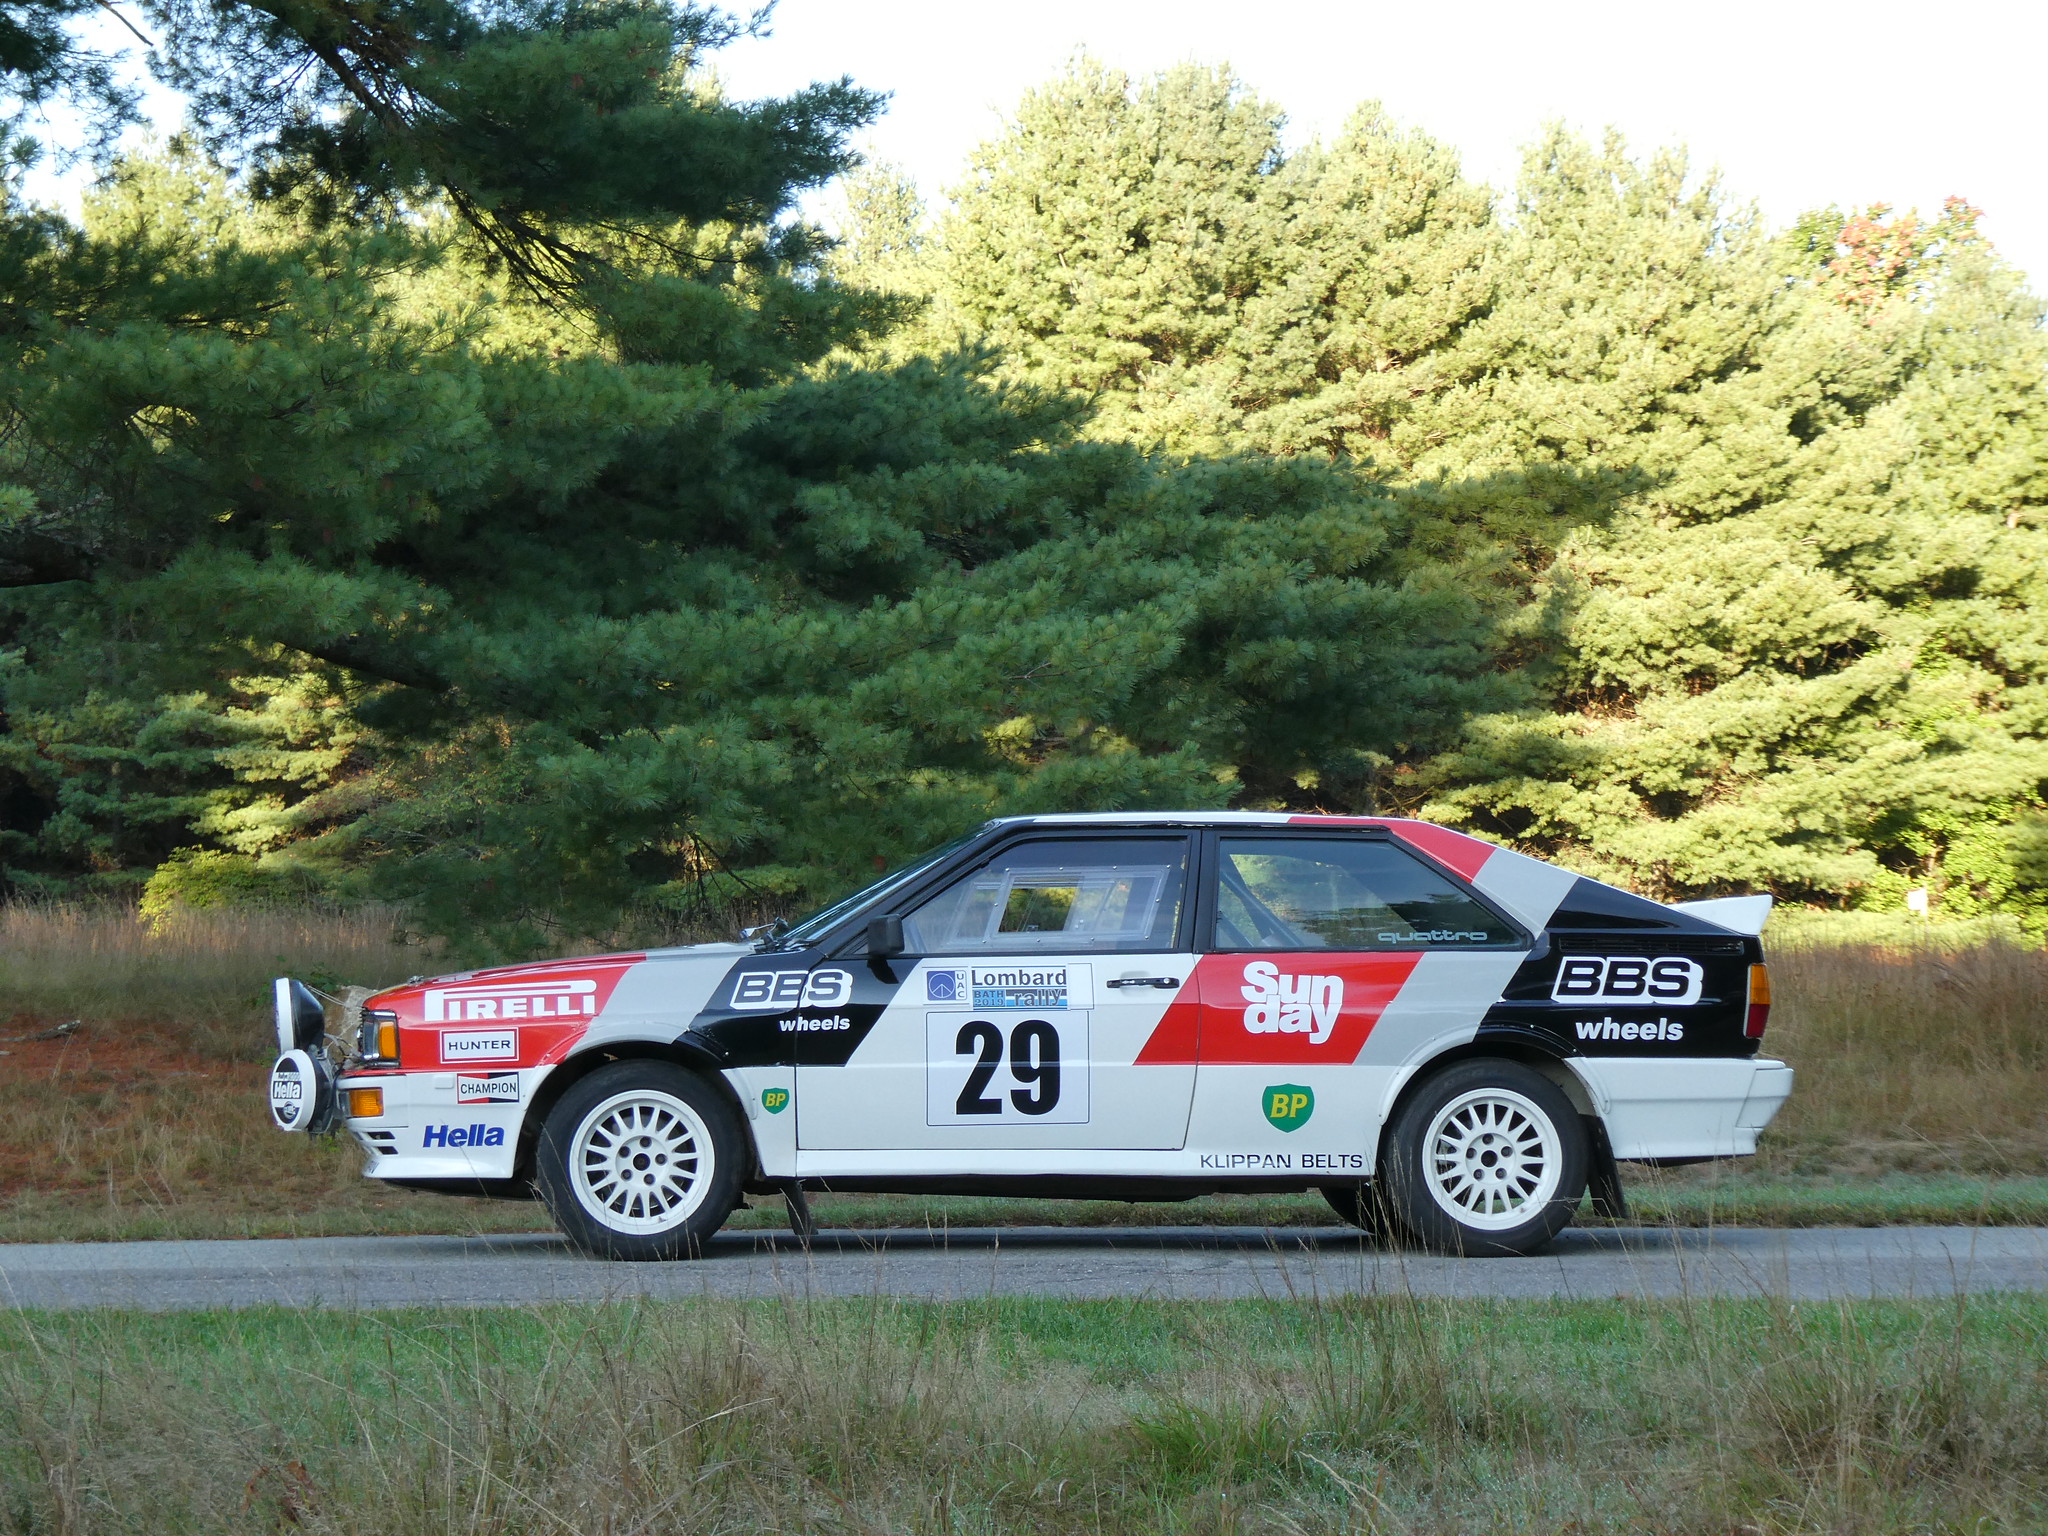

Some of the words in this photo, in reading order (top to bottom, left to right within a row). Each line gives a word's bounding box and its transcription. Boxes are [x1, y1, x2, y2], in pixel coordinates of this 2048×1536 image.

[1377, 929, 1488, 943] quattro
[971, 969, 1067, 986] Lombard
[1240, 961, 1344, 1004] Sun
[1550, 956, 1704, 1006] BBS
[729, 968, 853, 1010] BBS
[974, 990, 1004, 998] BATH
[1014, 988, 1063, 1007] rally
[424, 979, 597, 1022] PIRELLI
[974, 998, 1004, 1007] 2019
[779, 1015, 850, 1031] wheels
[1243, 994, 1343, 1045] day
[1575, 1017, 1684, 1041] wheels
[447, 1039, 511, 1050] HUNTER
[955, 1019, 1061, 1115] 29
[273, 1081, 301, 1099] Hella
[460, 1082, 517, 1094] CHAMPION
[765, 1092, 787, 1107] BP
[1269, 1093, 1308, 1118] BP
[423, 1124, 505, 1148] Hella
[1200, 1154, 1291, 1168] KLIPPAN
[1301, 1154, 1363, 1168] BELTS
